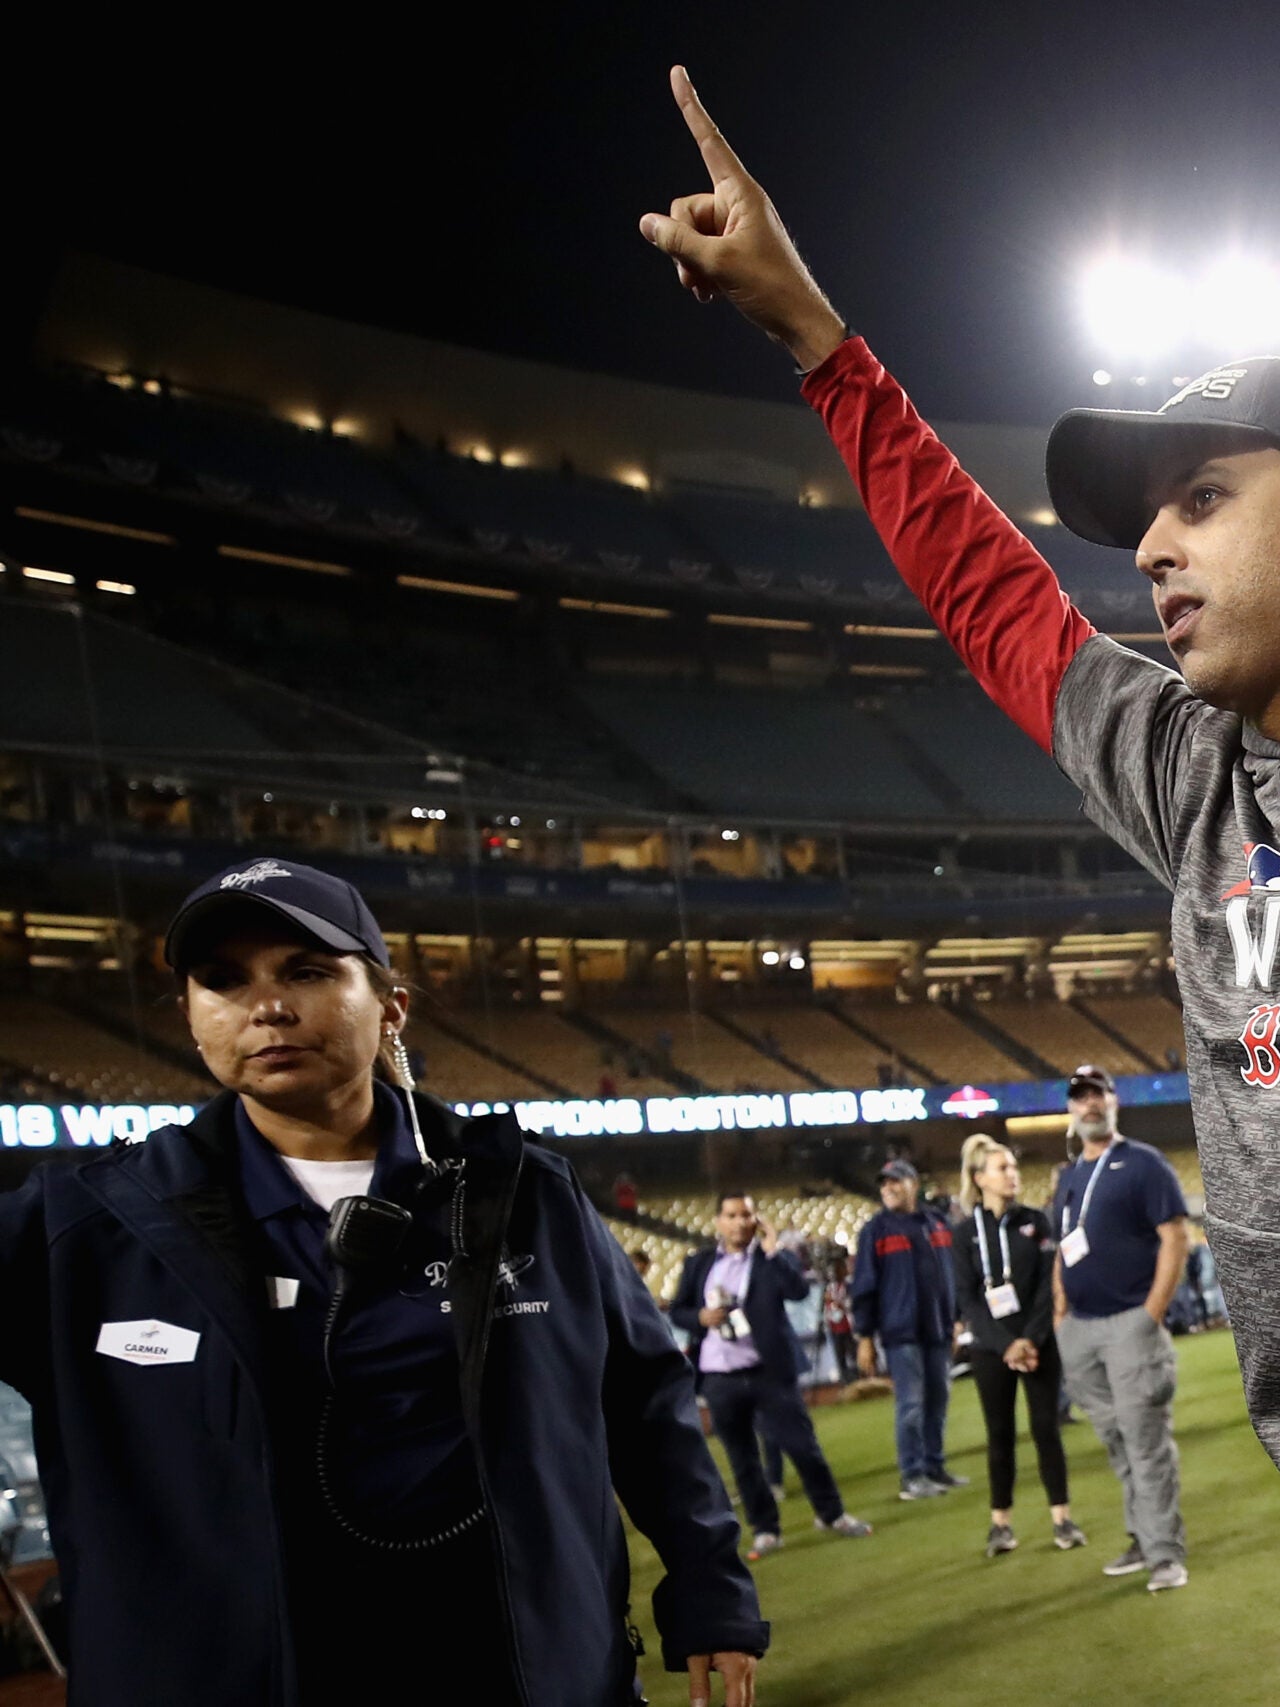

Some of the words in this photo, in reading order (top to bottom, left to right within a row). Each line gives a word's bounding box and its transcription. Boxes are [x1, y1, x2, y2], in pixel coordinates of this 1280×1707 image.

[61, 1104, 195, 1146] WOR
[454, 1098, 643, 1137] PIONS
[646, 1094, 786, 1133] BOSTON
[789, 1091, 858, 1127] RED
[860, 1088, 928, 1124] SOX
[493, 1301, 549, 1319] ECURITY
[124, 1343, 168, 1355] CARMEN
